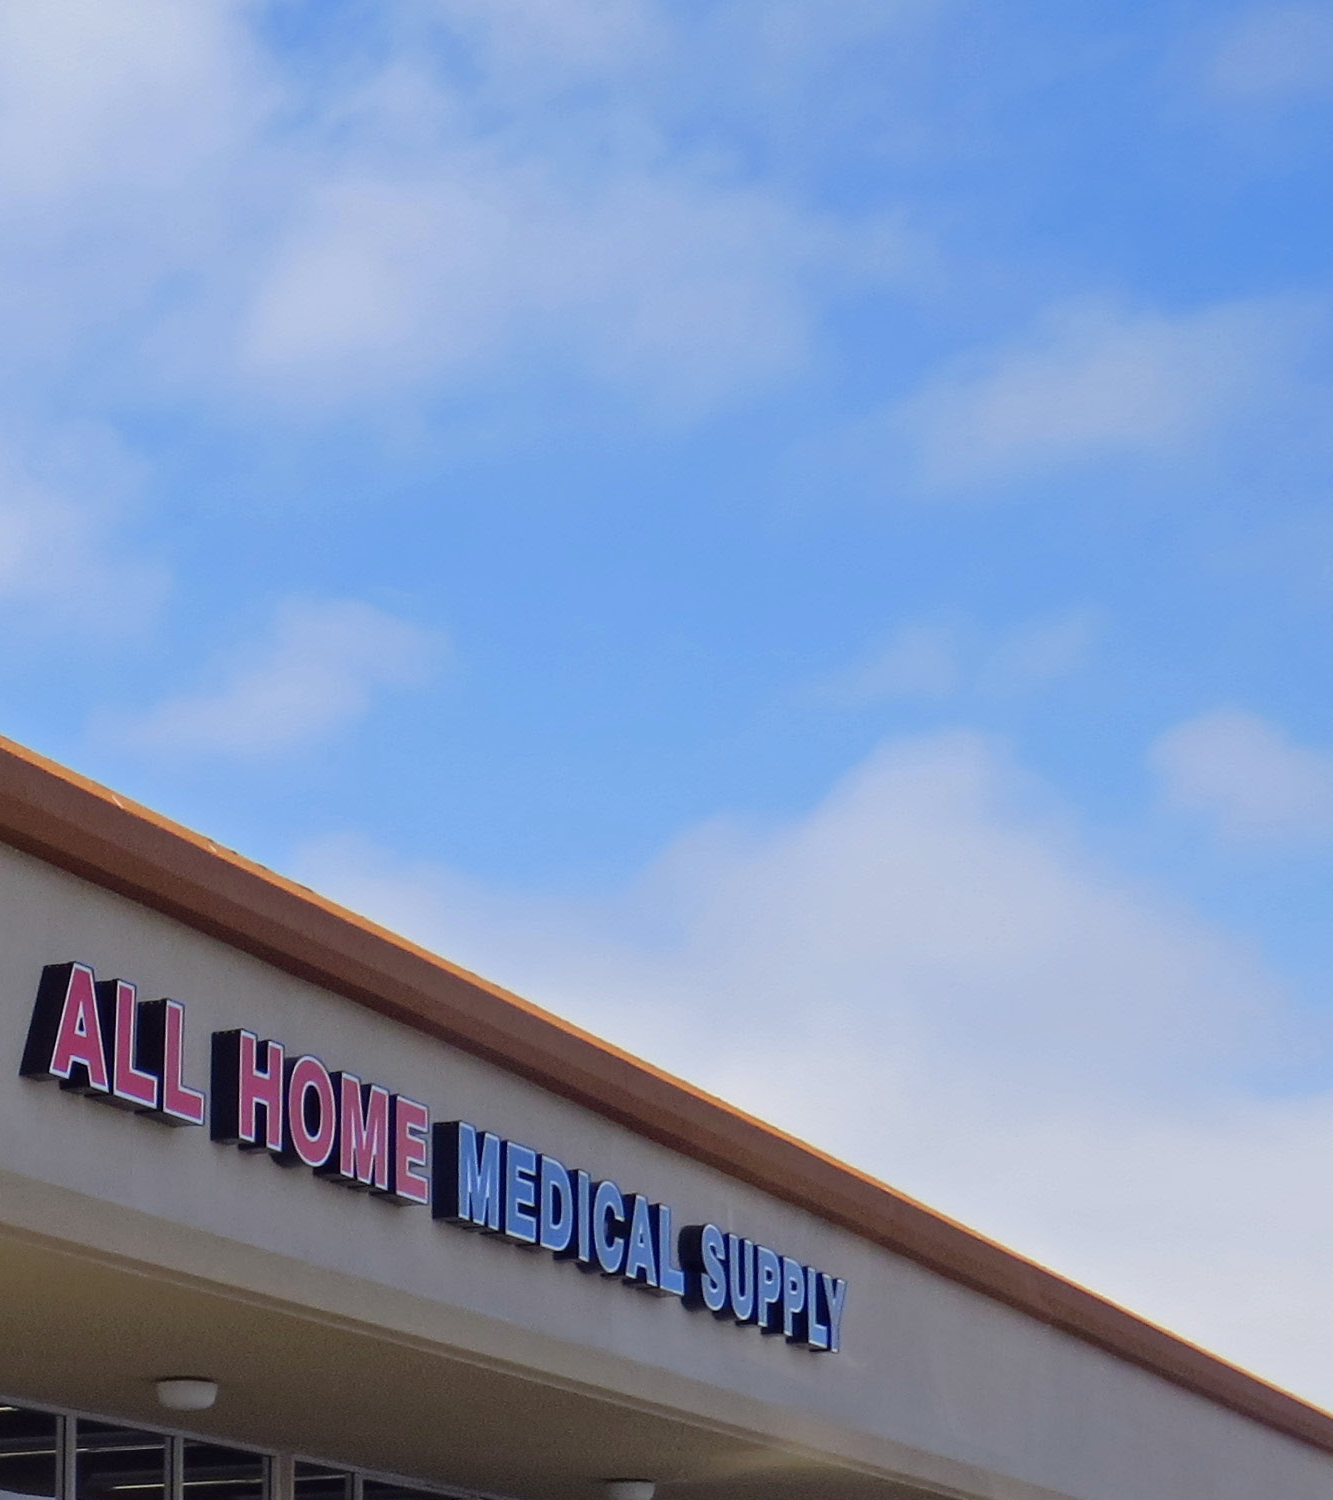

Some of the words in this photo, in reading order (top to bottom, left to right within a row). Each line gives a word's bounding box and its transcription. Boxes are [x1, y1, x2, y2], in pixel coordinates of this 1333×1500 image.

[48, 961, 205, 1126] ALL
[238, 1028, 429, 1206] HOME
[458, 1120, 685, 1296] MEDICAL
[701, 1223, 848, 1353] SUPPLY
